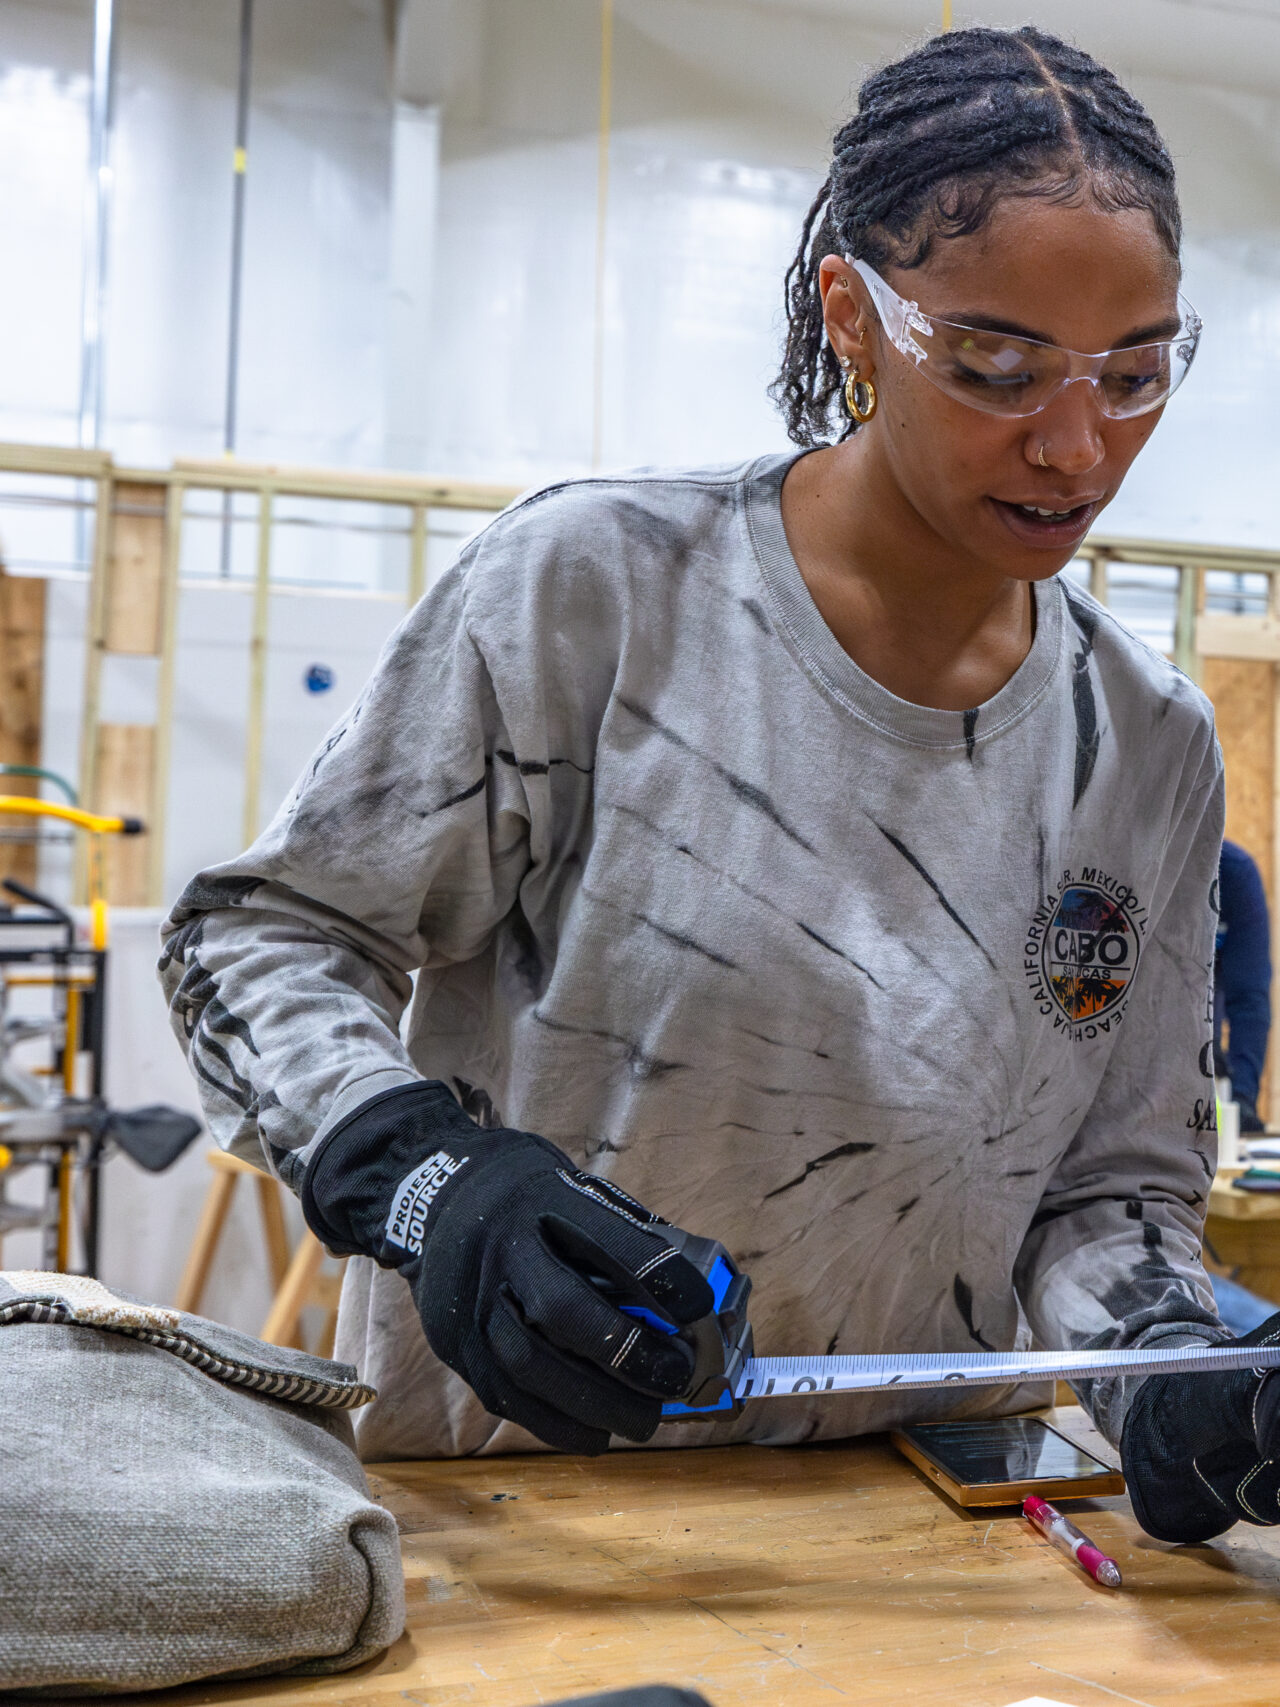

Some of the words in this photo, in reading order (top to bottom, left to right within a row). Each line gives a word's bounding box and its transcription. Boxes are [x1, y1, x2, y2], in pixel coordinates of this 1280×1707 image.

[1024, 894, 1058, 1016] CALIFORNIA
[1081, 867, 1139, 911] MEXICO
[1055, 929, 1128, 966] CABO
[1075, 1001, 1129, 1043] EACH
[392, 1159, 441, 1238] PROJECT
